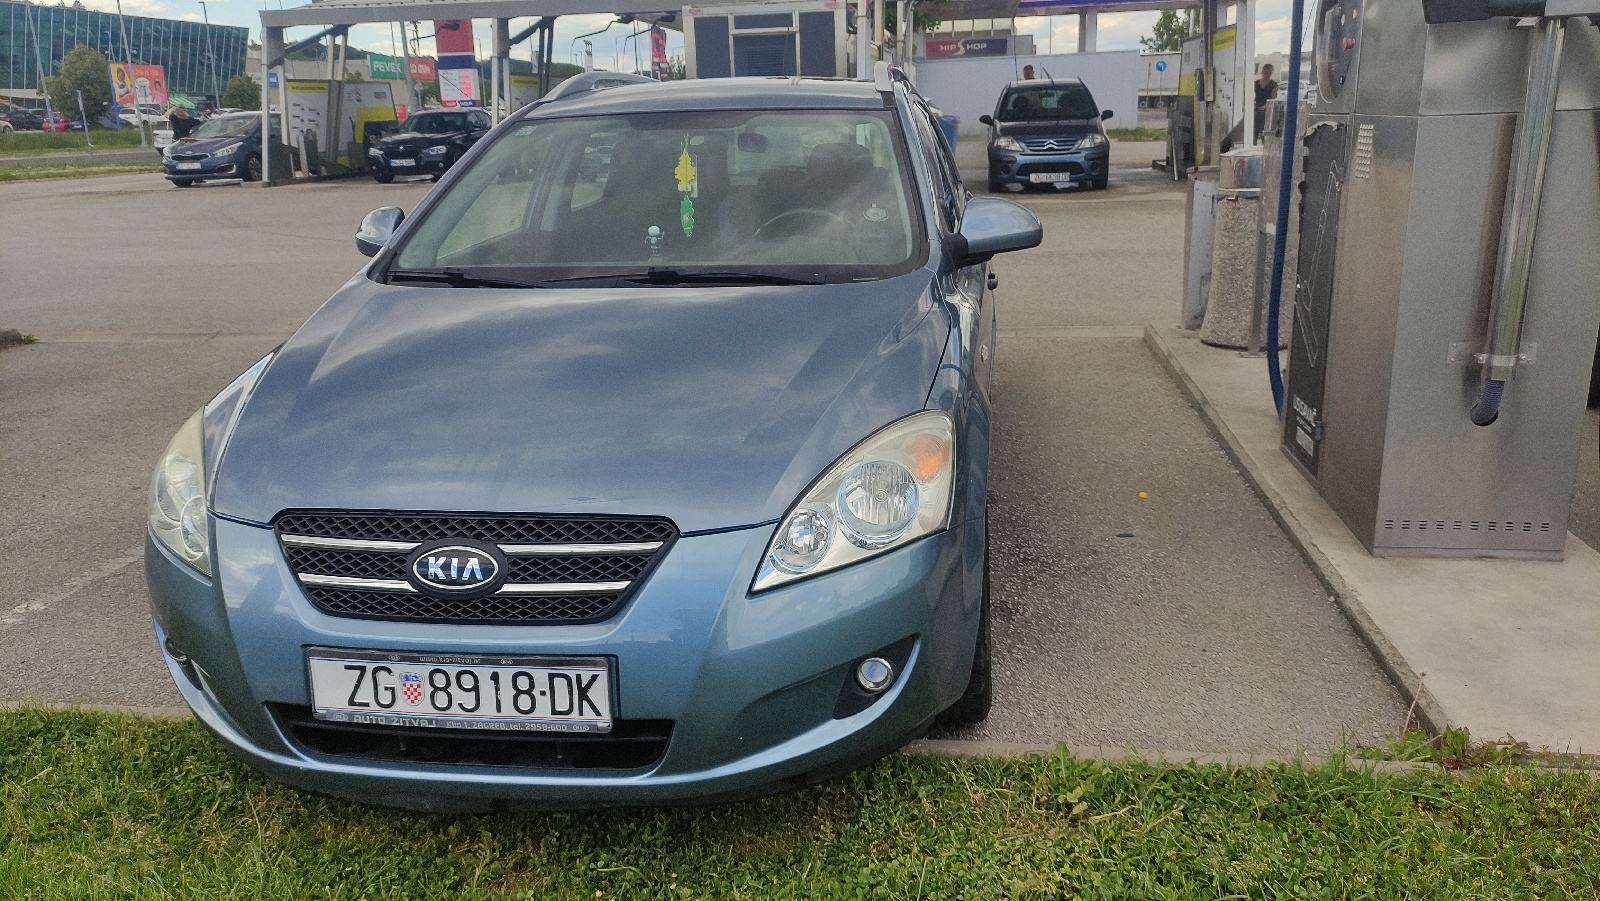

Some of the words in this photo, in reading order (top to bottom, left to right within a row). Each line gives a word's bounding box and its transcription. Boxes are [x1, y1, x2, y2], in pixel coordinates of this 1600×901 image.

[428, 556, 484, 580] KIA
[344, 664, 396, 709] ZG
[353, 714, 386, 725] AUTO
